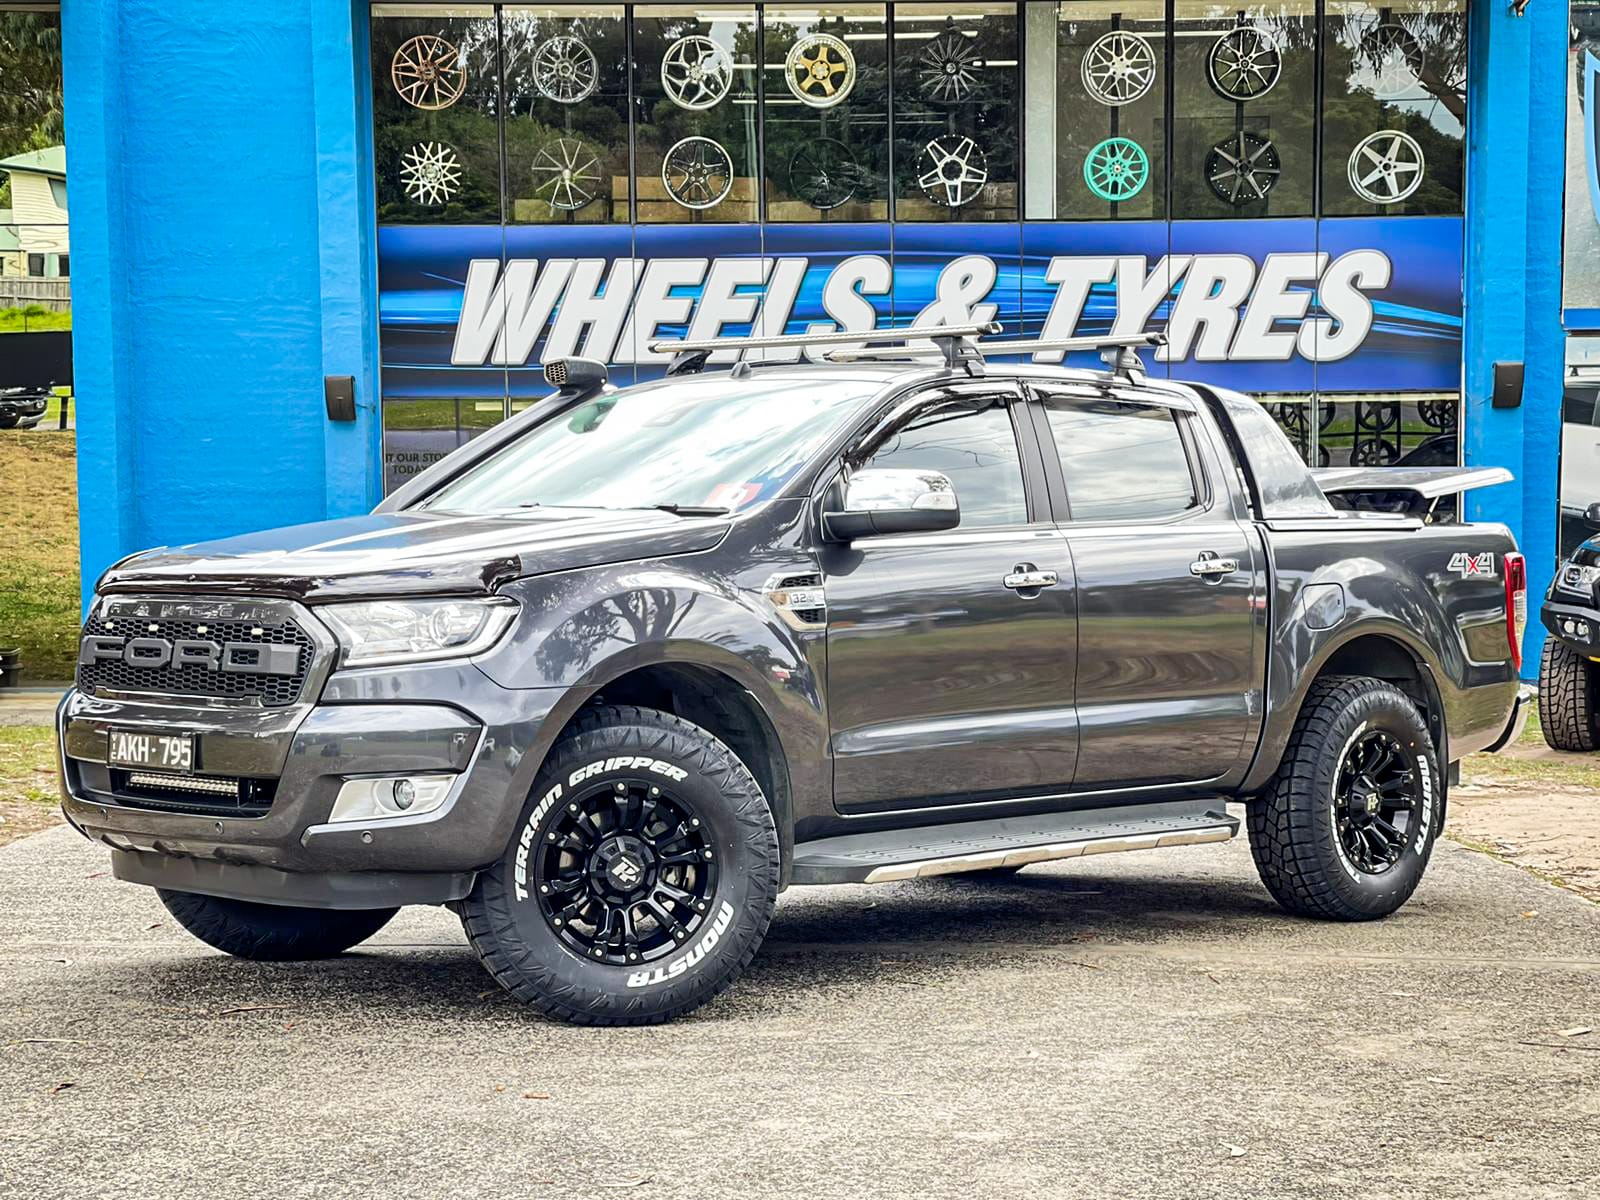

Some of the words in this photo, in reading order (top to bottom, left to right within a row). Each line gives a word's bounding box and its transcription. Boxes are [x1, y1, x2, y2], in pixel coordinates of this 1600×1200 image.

[450, 254, 891, 365] WHEELS
[904, 254, 997, 365] &
[1031, 248, 1393, 362] TYRES
[396, 453, 419, 462] OUR
[79, 635, 302, 676] FORD
[514, 783, 563, 902] TERRAIN
[568, 756, 689, 787] GRIPPER
